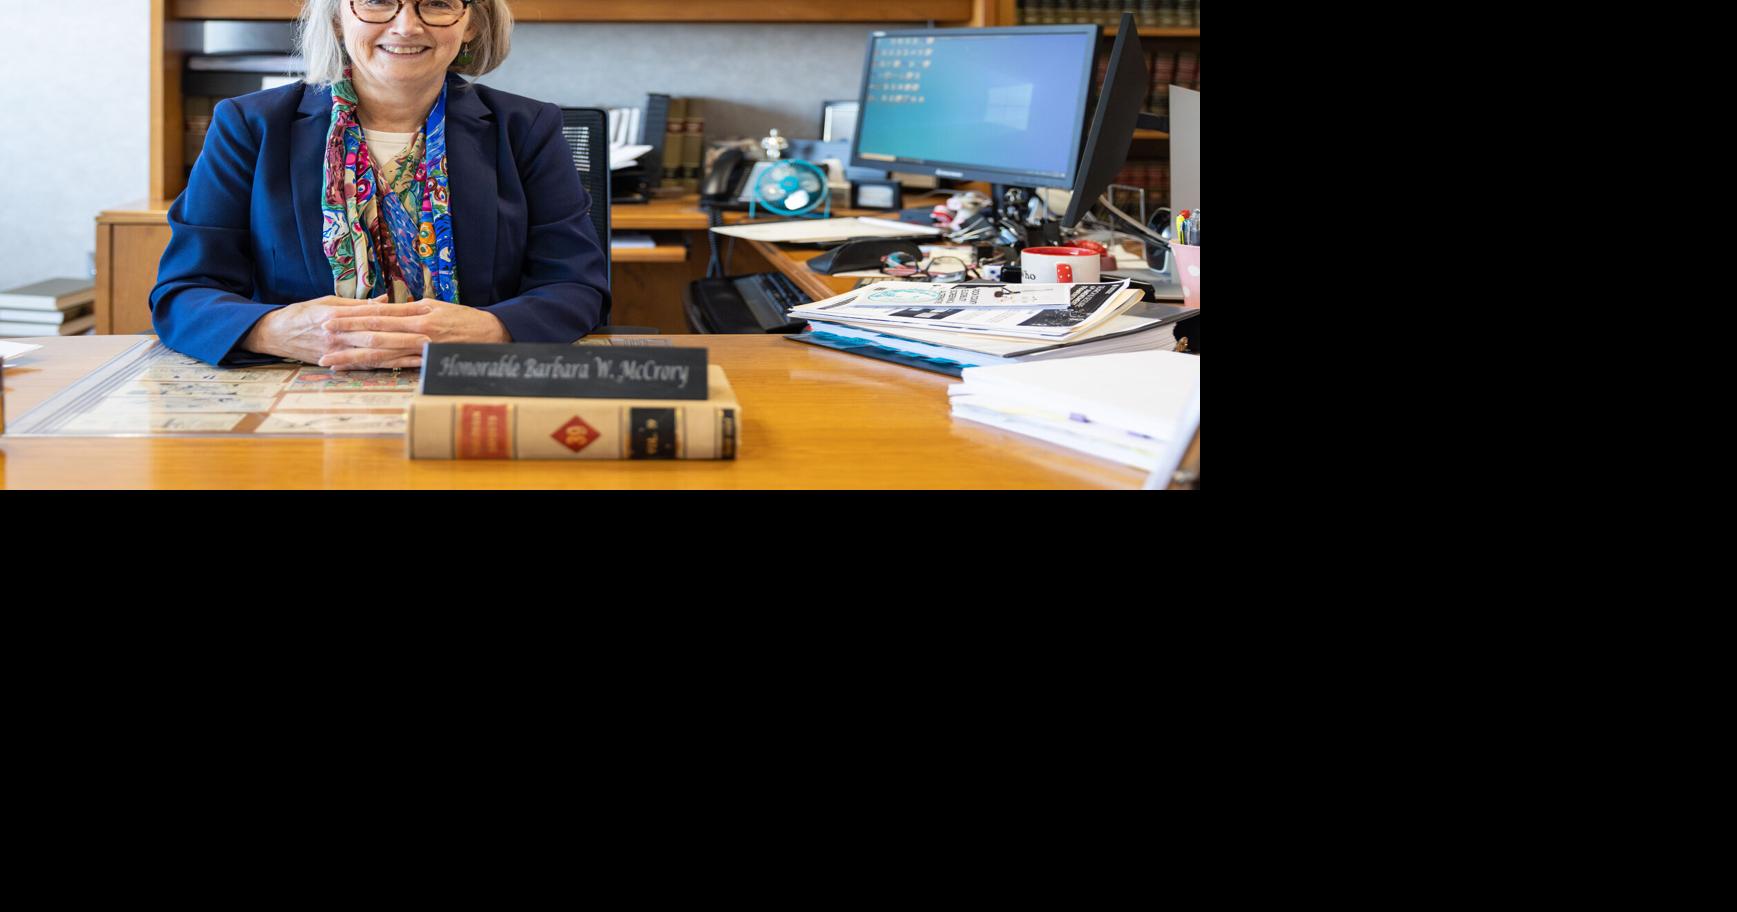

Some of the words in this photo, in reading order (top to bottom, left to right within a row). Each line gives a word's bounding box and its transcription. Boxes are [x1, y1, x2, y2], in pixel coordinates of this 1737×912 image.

[1021, 270, 1036, 281] ho
[437, 353, 520, 378] Honorable
[523, 355, 589, 379] Barbara
[593, 356, 615, 379] W.
[617, 359, 690, 389] McCrory
